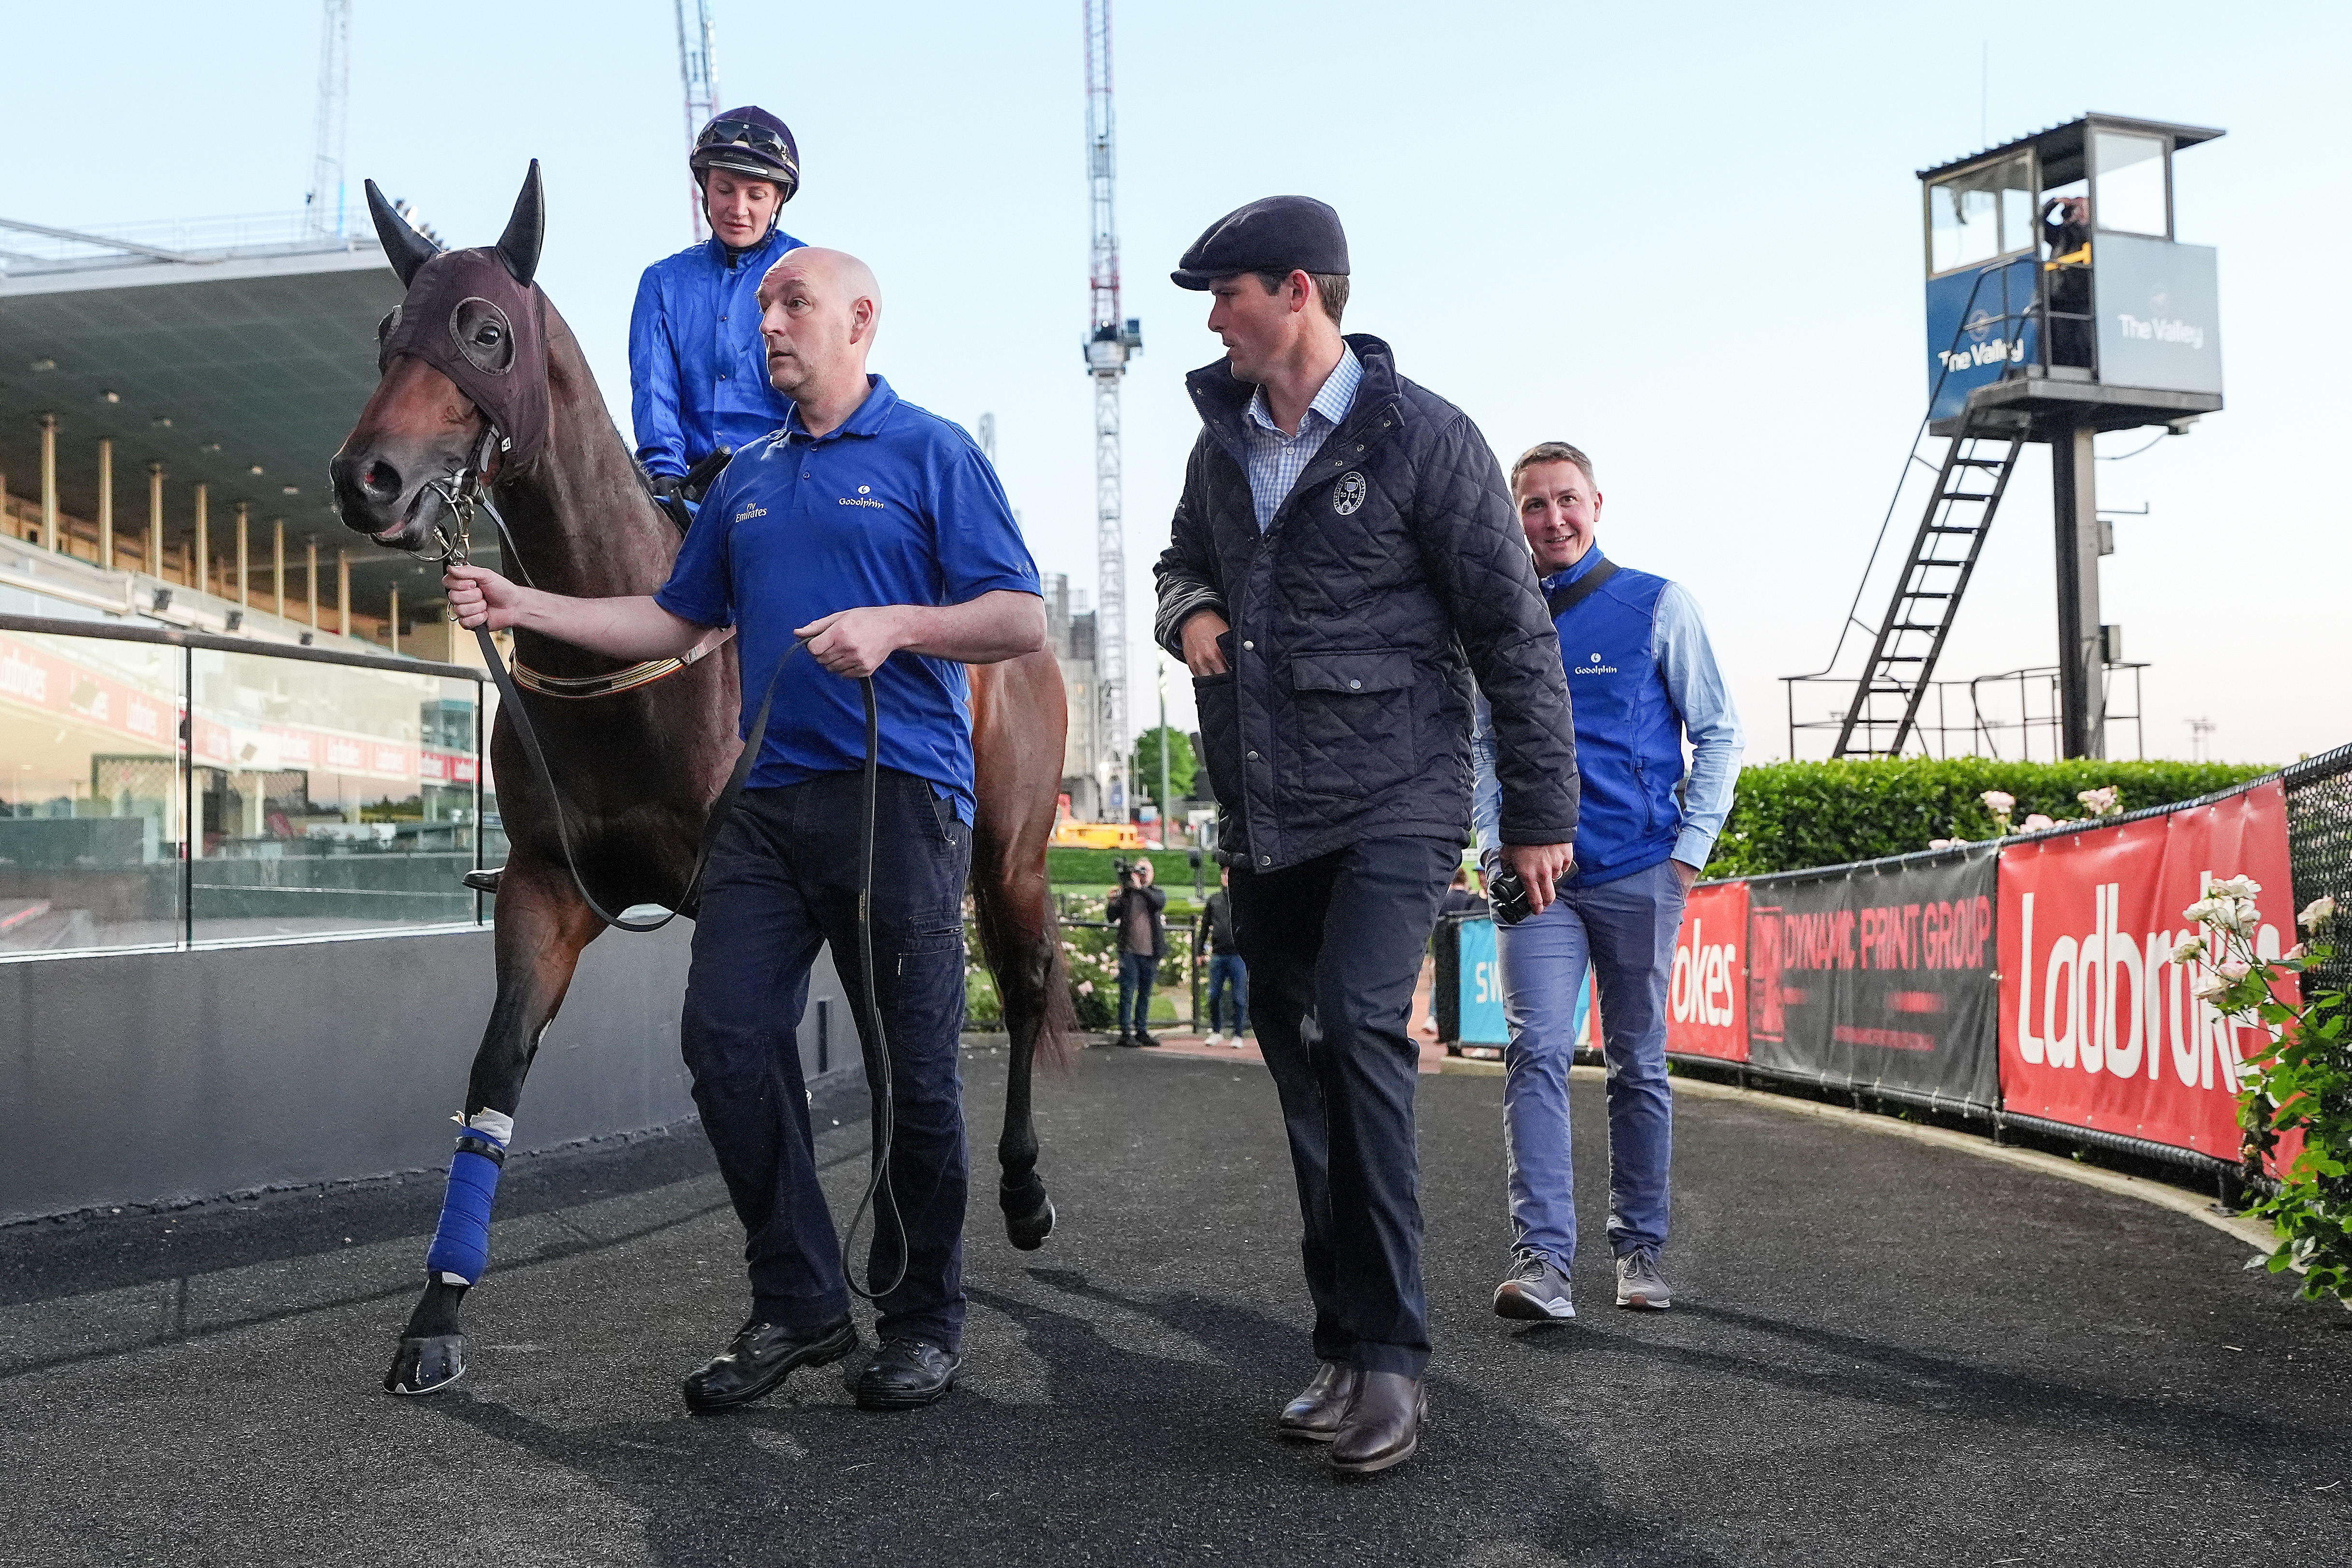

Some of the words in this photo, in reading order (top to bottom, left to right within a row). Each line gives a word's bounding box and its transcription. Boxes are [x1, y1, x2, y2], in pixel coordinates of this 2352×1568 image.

[2117, 314, 2152, 340] The
[2151, 317, 2204, 349] Valley
[1938, 350, 1972, 373] The
[839, 497, 885, 509] Godolphin
[735, 508, 768, 523] Emirates
[1575, 664, 1617, 675] Godolphin
[1860, 903, 1921, 969] PRINT
[1923, 895, 1991, 970] GROUP
